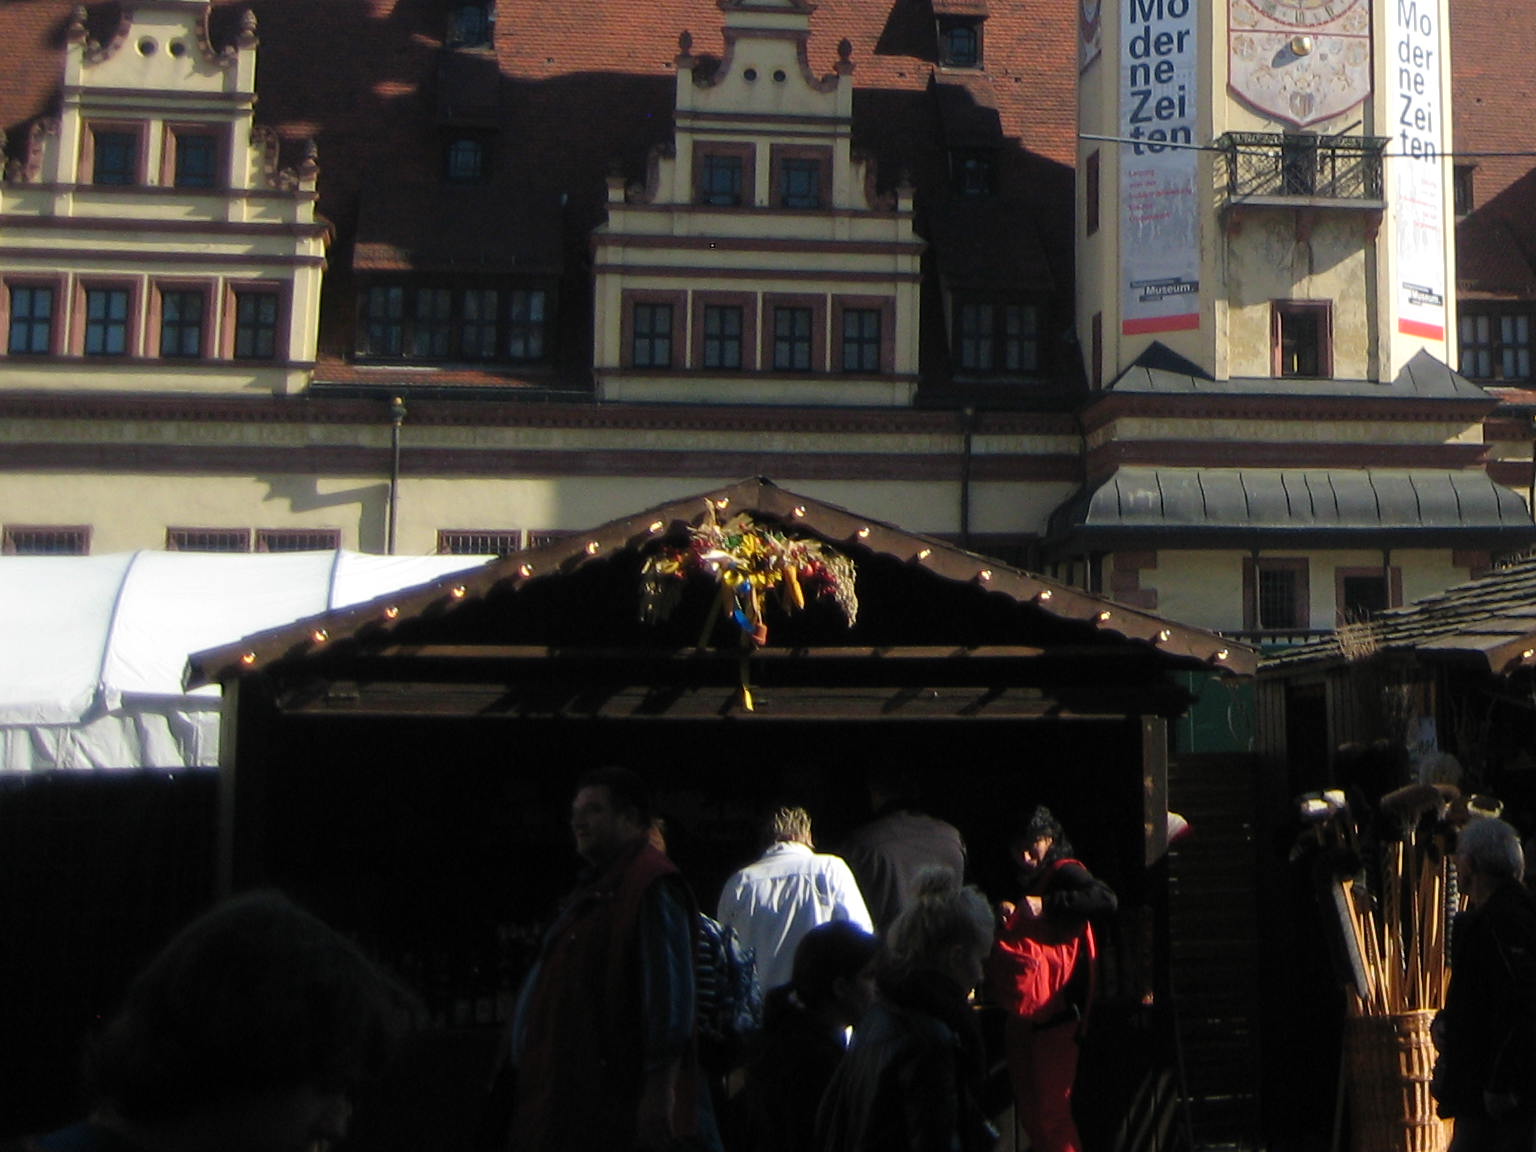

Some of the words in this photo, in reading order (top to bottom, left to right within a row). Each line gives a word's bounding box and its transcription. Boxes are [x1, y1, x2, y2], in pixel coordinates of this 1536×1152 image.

[1128, 24, 1191, 60] der
[1398, 33, 1433, 71] der
[1130, 58, 1175, 88] ne
[1399, 66, 1425, 96] ne
[1129, 84, 1187, 125] Zei
[1400, 92, 1433, 133] Zei
[1130, 126, 1192, 156] ten
[1399, 128, 1437, 165] ten
